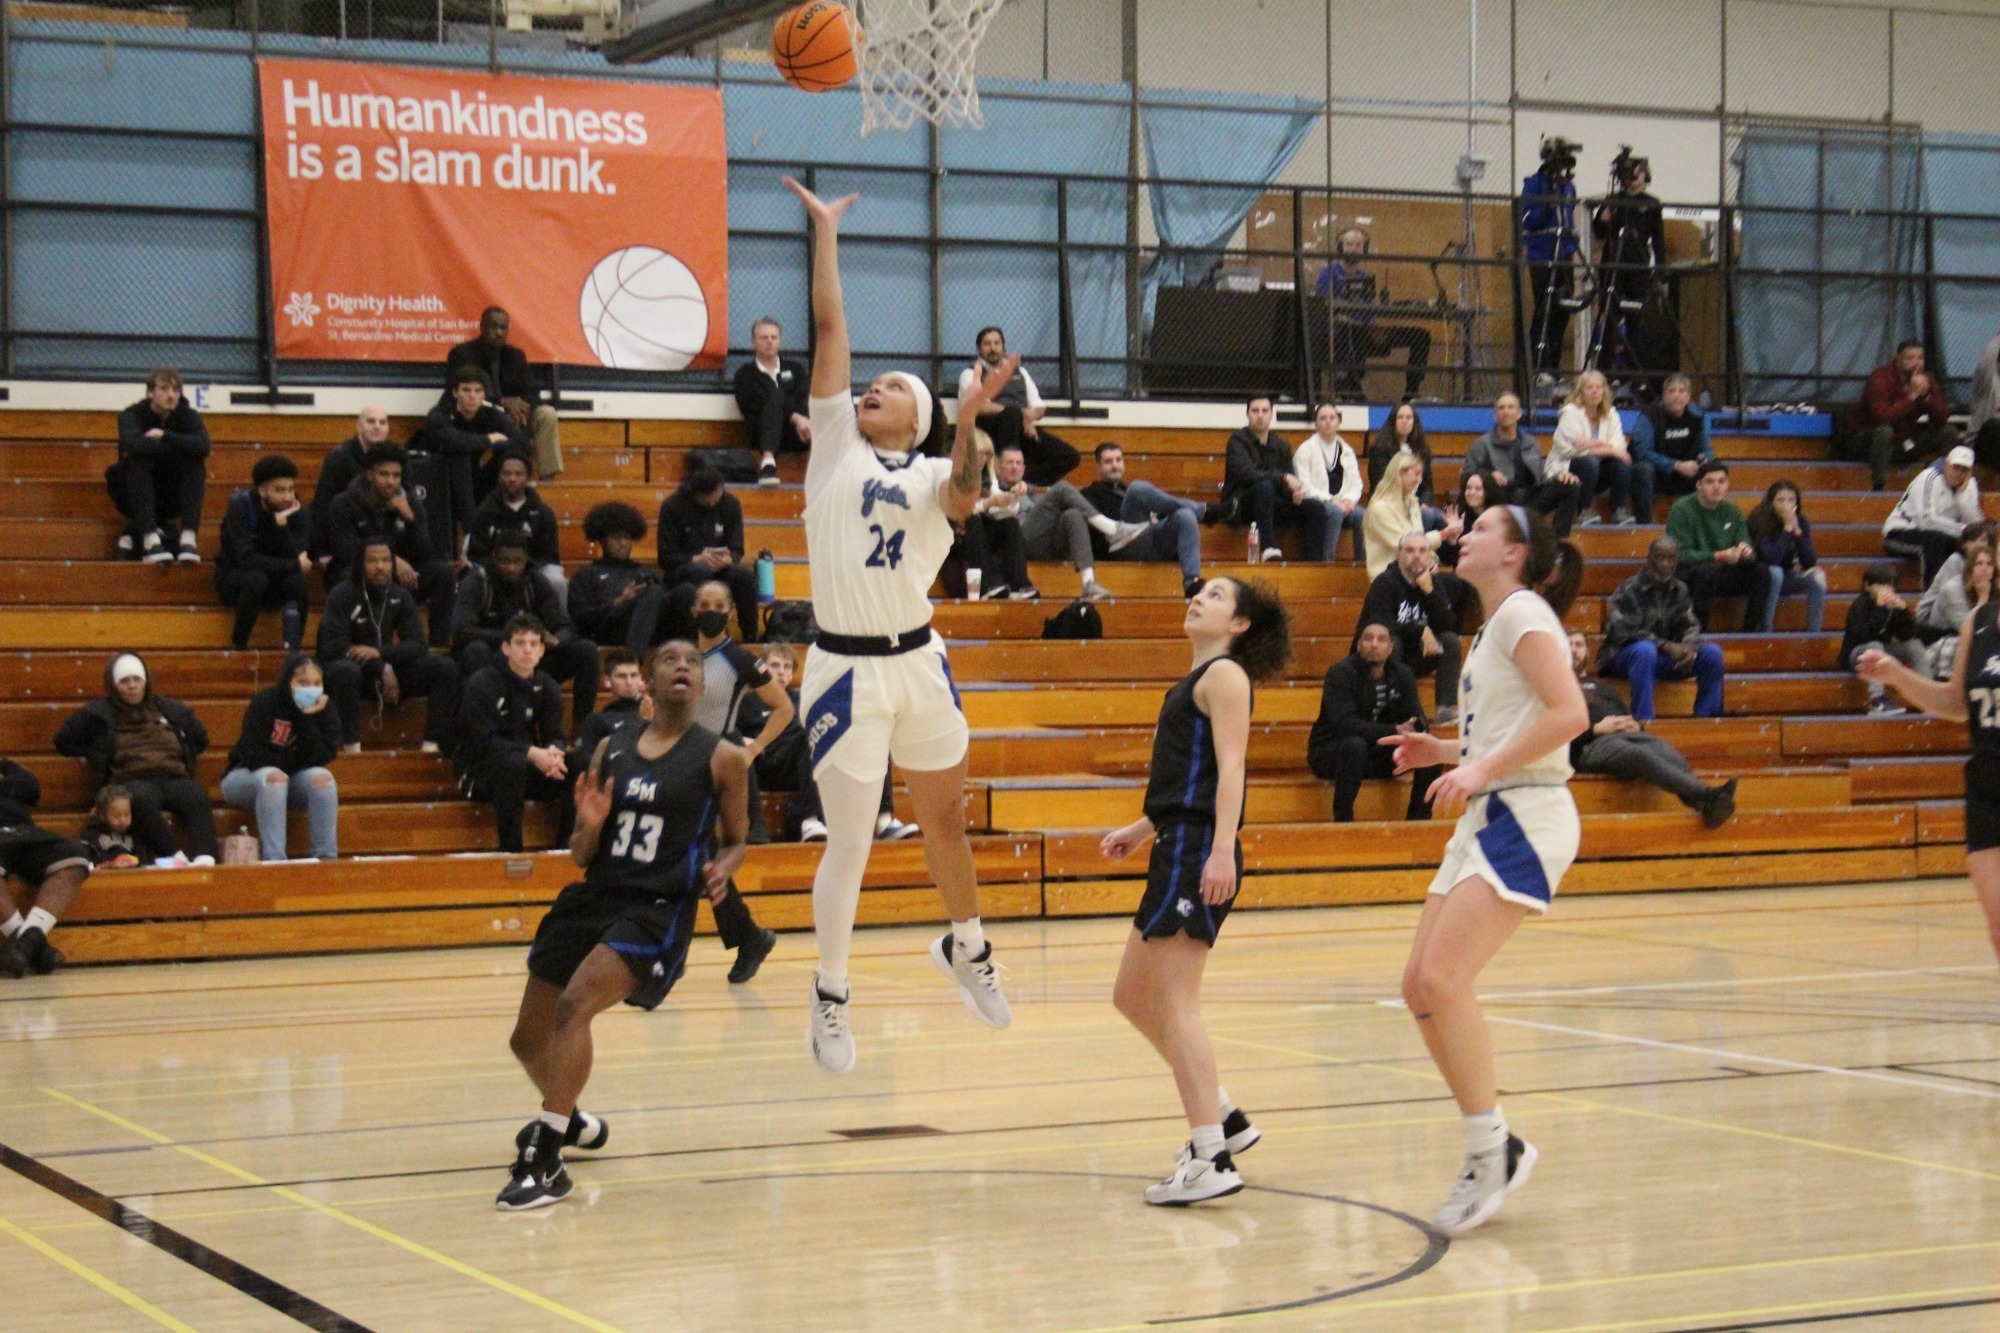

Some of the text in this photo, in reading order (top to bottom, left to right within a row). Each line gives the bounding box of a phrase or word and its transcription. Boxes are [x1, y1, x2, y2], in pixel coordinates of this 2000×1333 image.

[283, 79, 649, 146] Humankindness
[288, 130, 617, 195] is a slam dunk.
[327, 292, 386, 316] Dignity
[327, 316, 384, 330] Community
[386, 318, 425, 331] Hospital
[427, 319, 436, 329] of
[439, 319, 457, 330] San
[396, 331, 433, 342] Medical
[434, 332, 467, 343] Center
[864, 523, 906, 570] 24
[611, 810, 664, 863] 33
